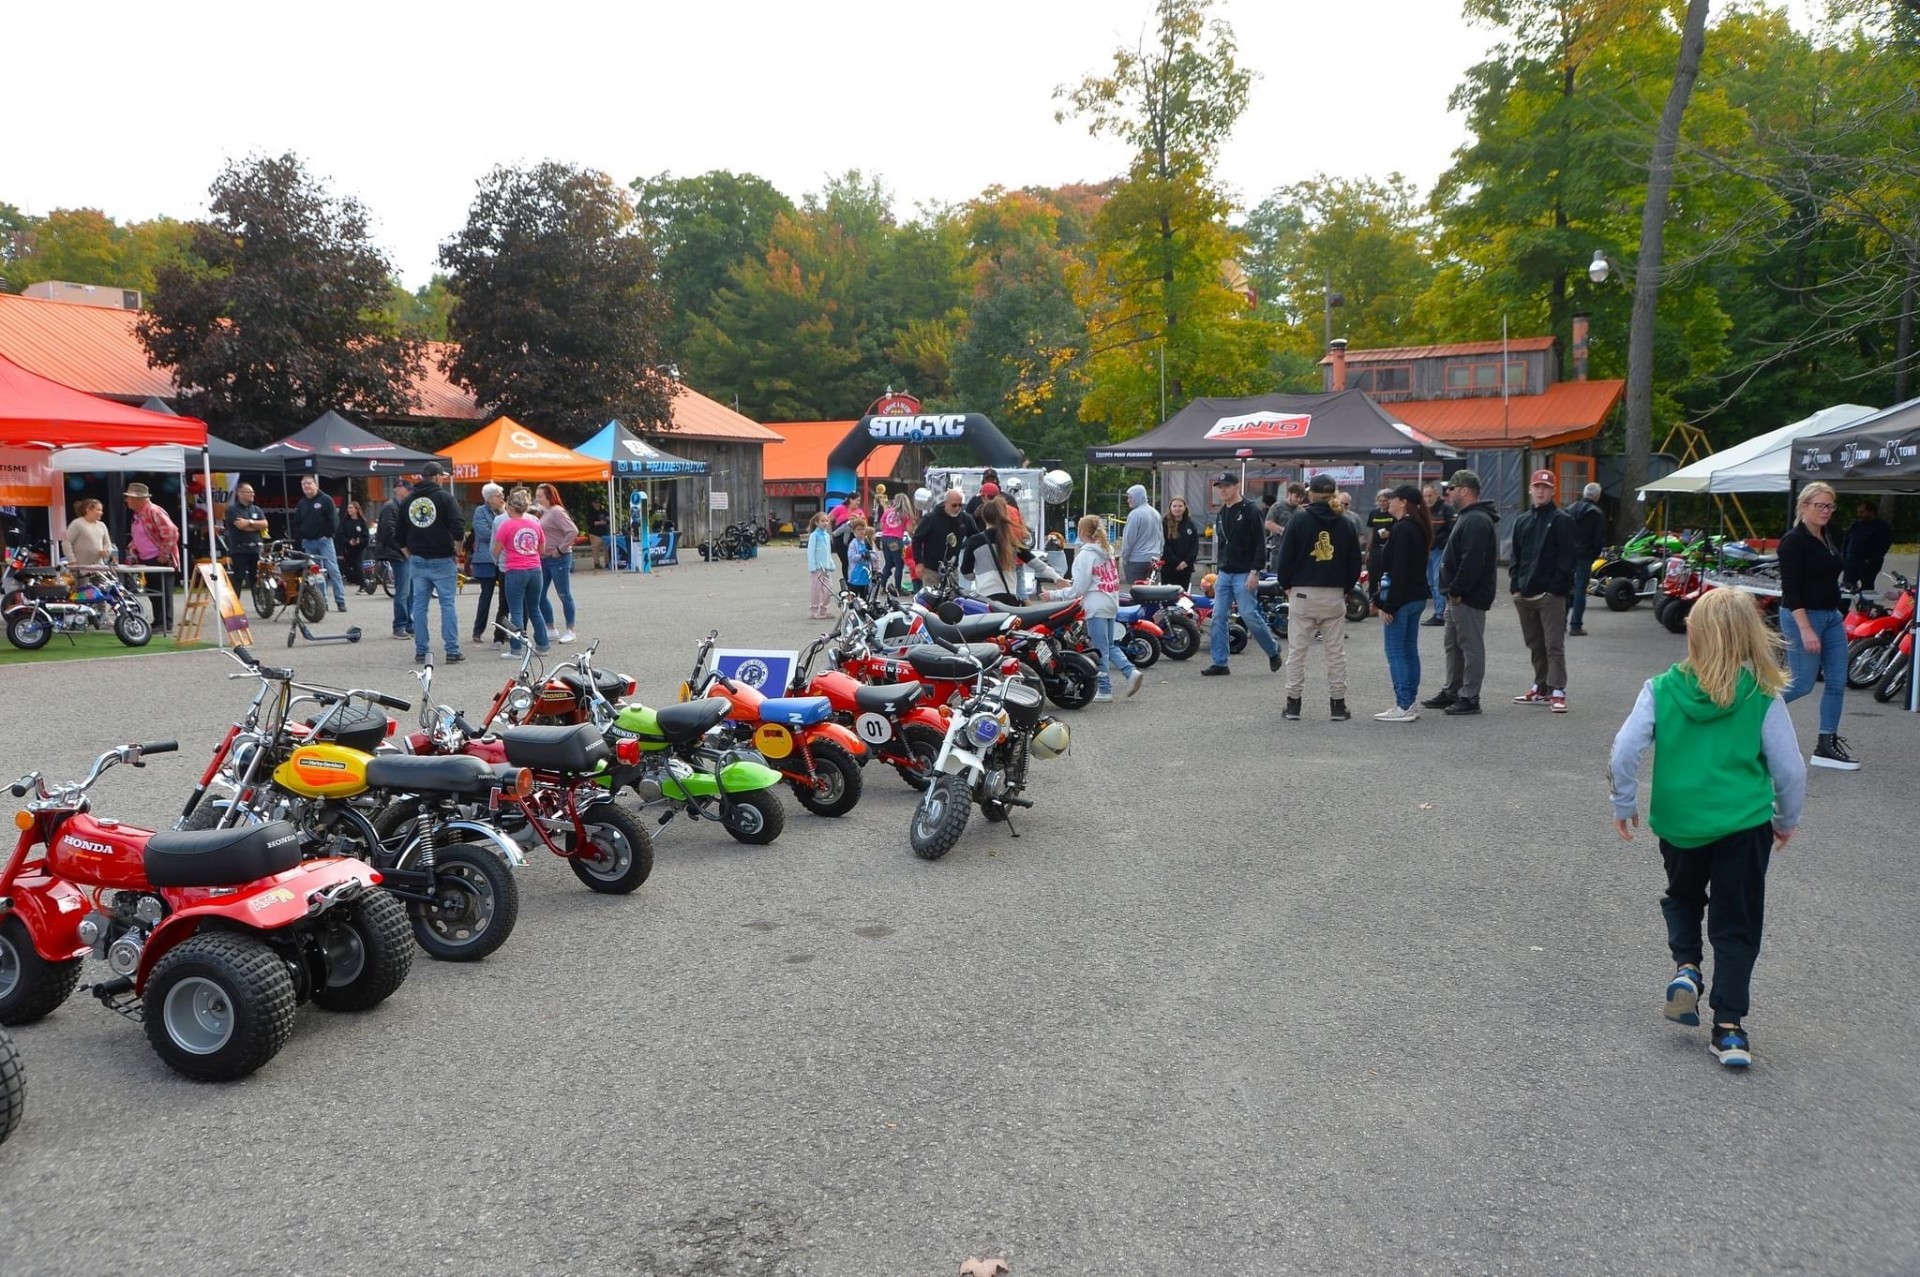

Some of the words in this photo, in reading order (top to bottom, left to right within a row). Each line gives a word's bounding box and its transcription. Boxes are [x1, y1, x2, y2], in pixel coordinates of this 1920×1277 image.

[867, 415, 967, 437] STACYC
[1220, 420, 1298, 433] SINTO
[765, 484, 824, 496] TEXACO
[871, 664, 910, 676] HONDA
[884, 702, 896, 712] Z
[612, 729, 639, 739] HONDA
[866, 720, 883, 737] 01
[63, 834, 114, 855] HONDA
[266, 834, 297, 850] HONDA
